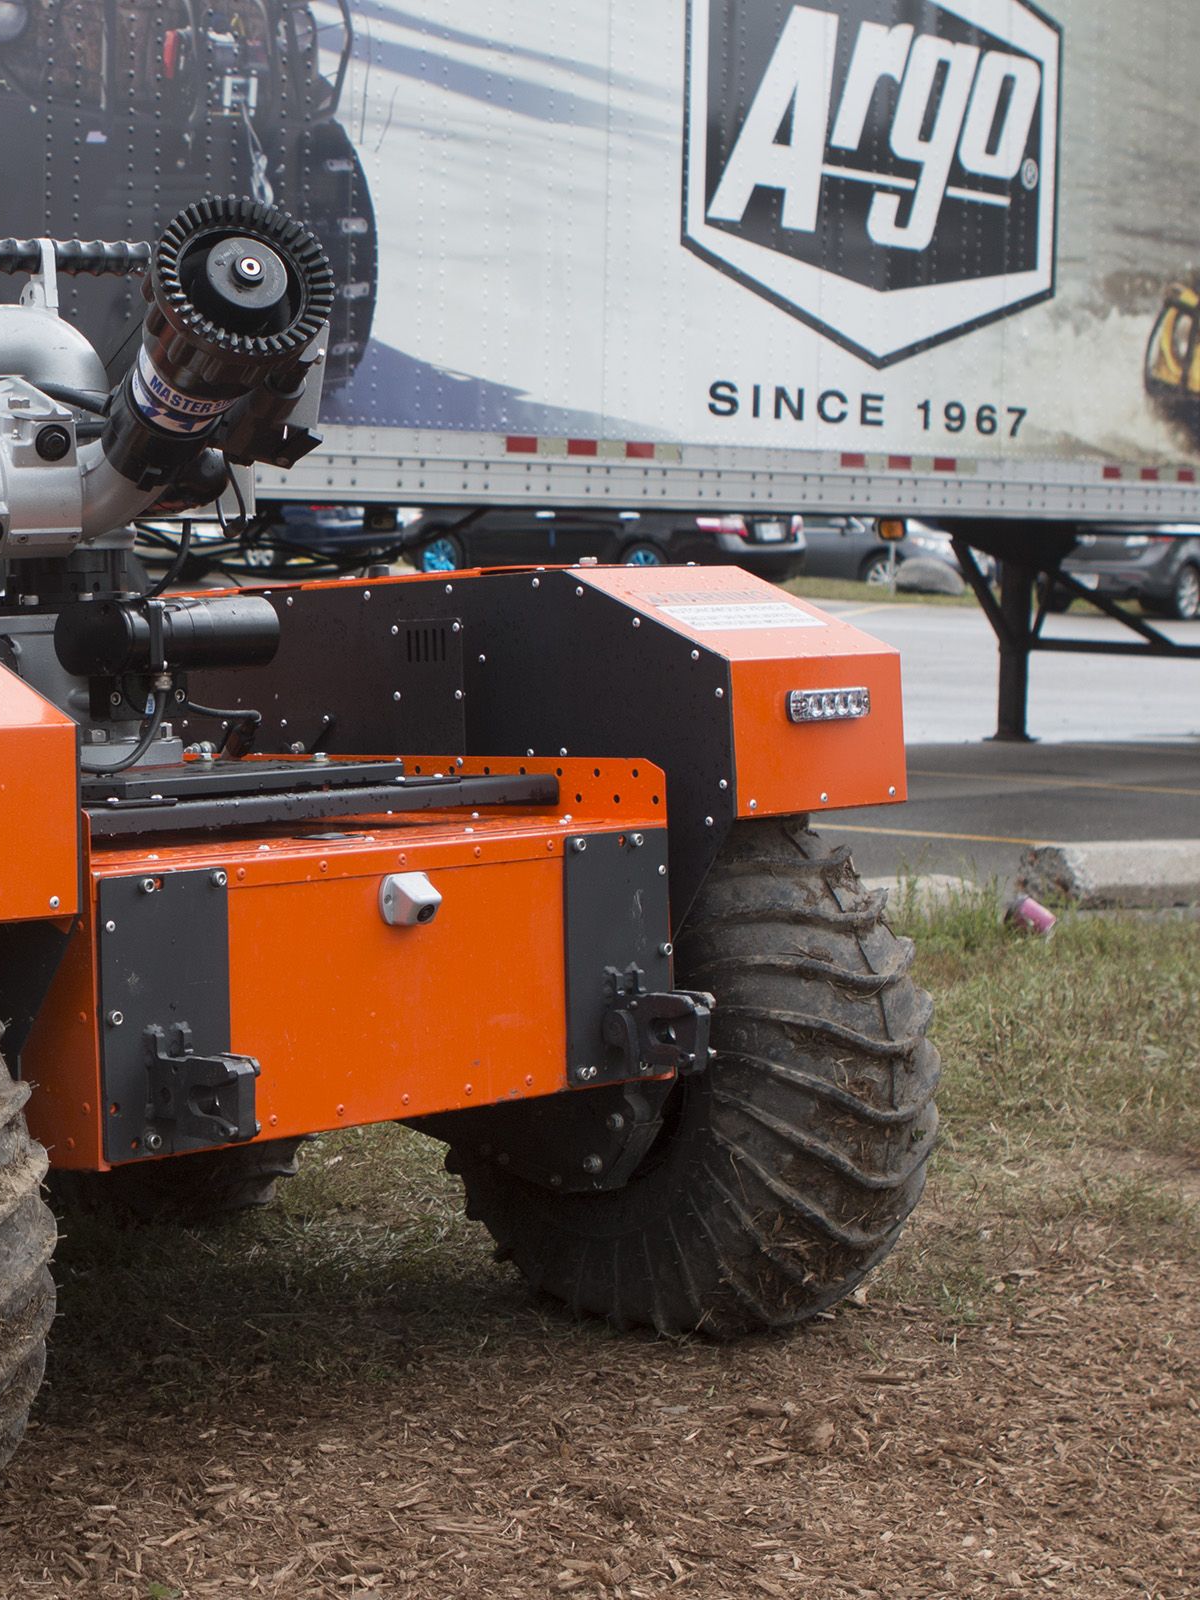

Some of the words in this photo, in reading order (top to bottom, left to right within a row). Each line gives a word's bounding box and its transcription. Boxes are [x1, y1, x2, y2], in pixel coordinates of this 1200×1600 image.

[706, 4, 1042, 251] Argo
[150, 374, 212, 413] MASTER
[707, 380, 886, 427] SINCE
[916, 399, 1028, 438] 1967
